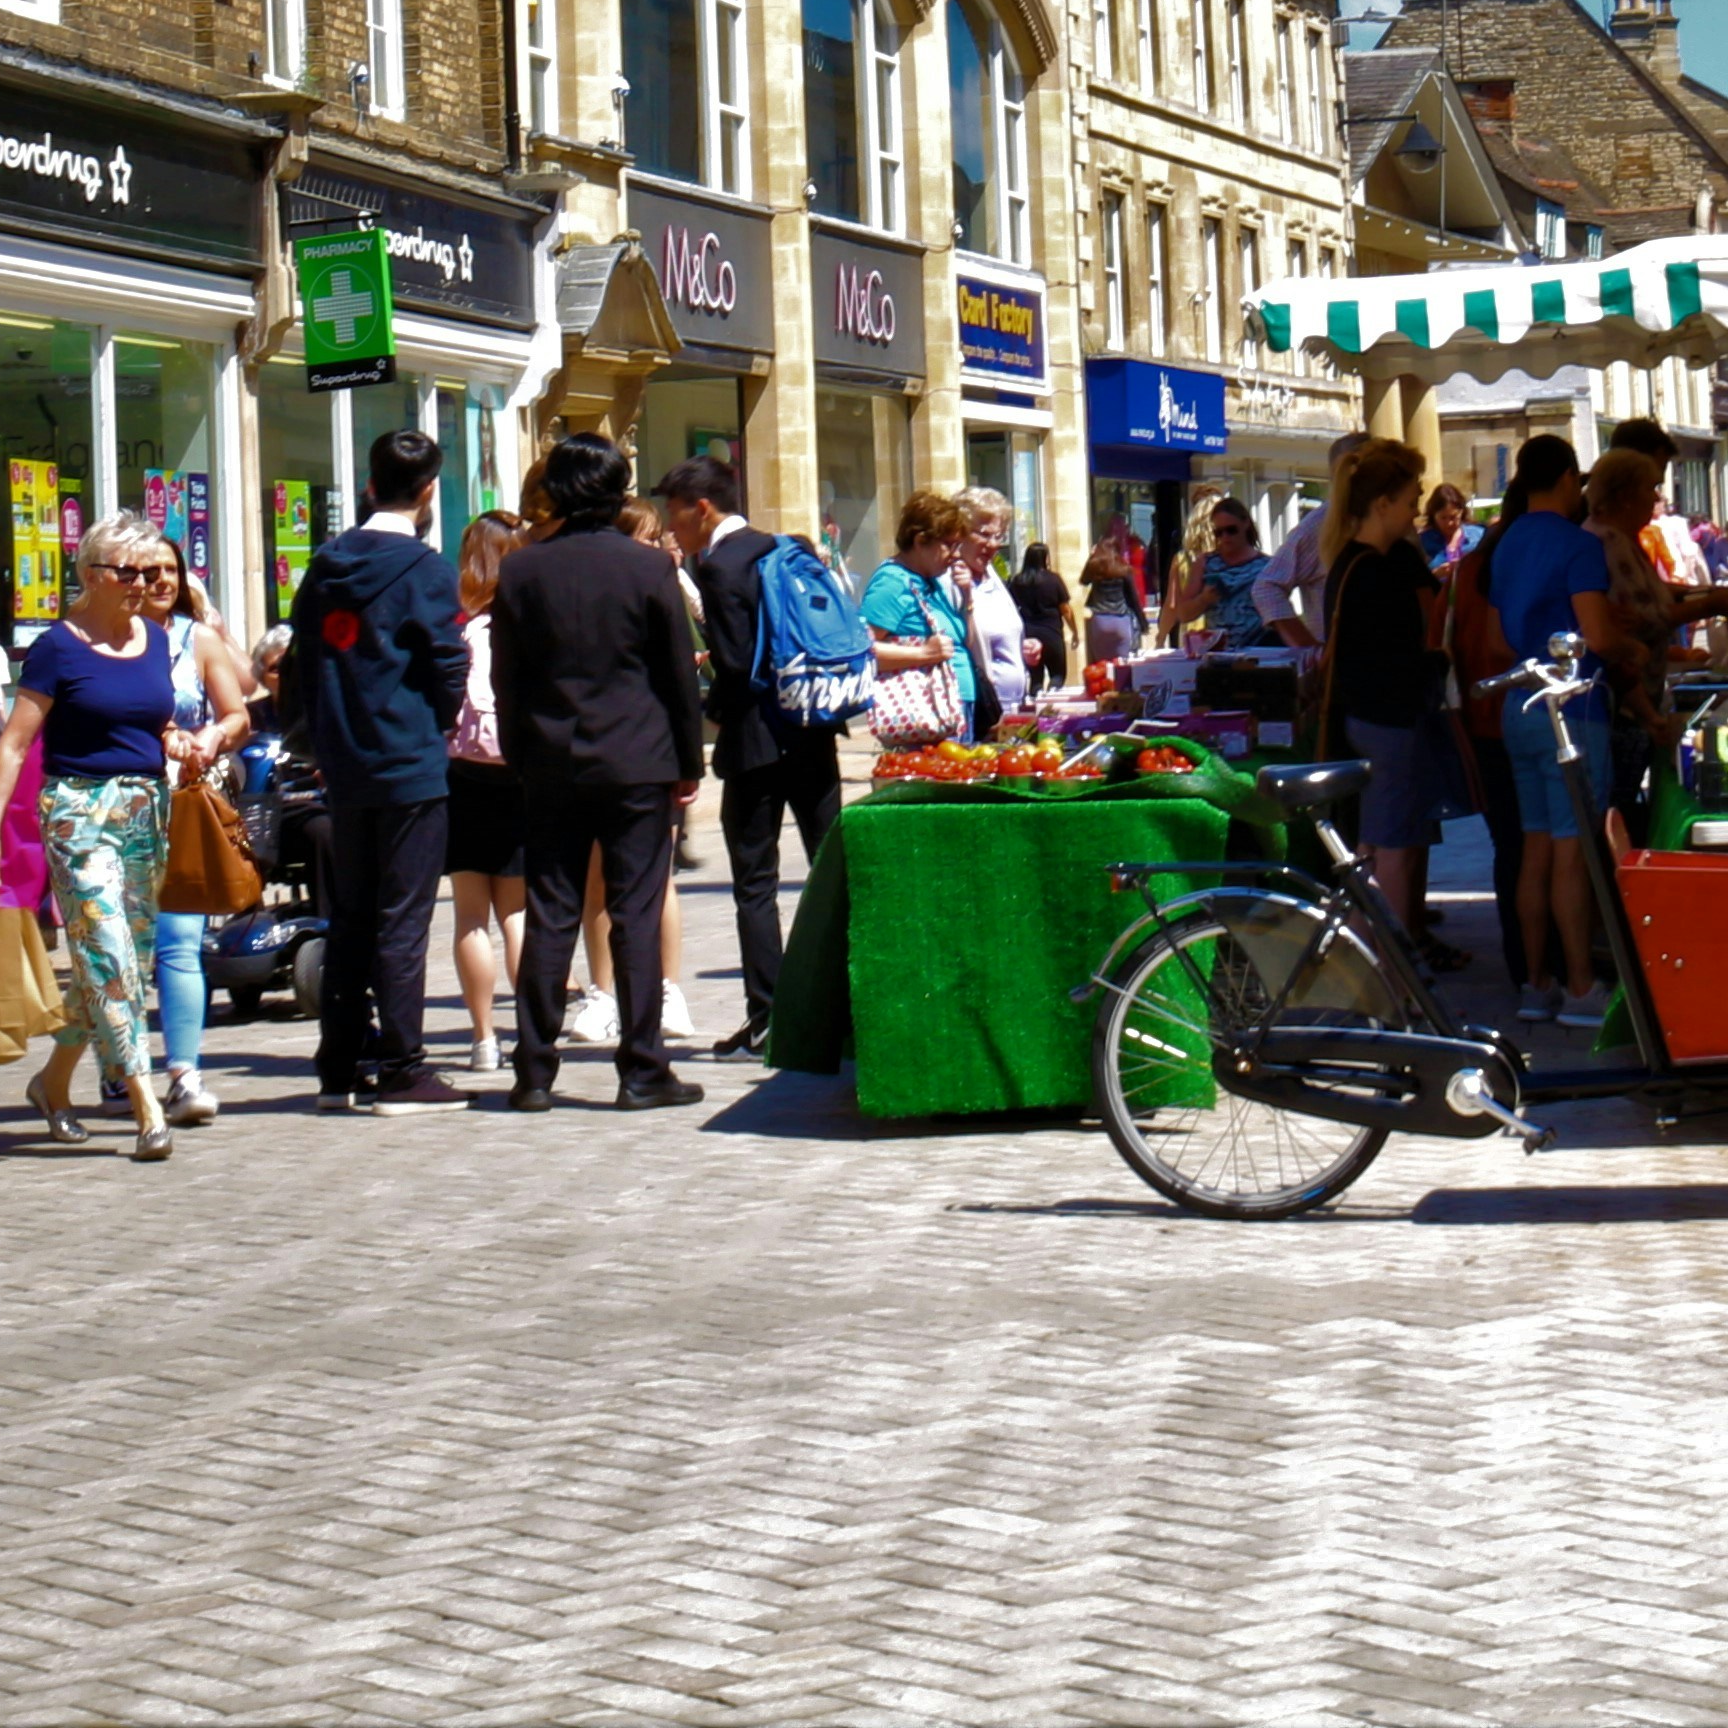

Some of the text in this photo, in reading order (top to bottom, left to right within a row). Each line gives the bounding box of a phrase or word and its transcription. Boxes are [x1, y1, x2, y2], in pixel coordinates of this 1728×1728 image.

[303, 238, 373, 260] PHARMACY
[663, 224, 736, 313] M&Co
[836, 262, 896, 342] M&Co
[959, 285, 1033, 345] Card Factory
[310, 370, 383, 388] Superdrug
